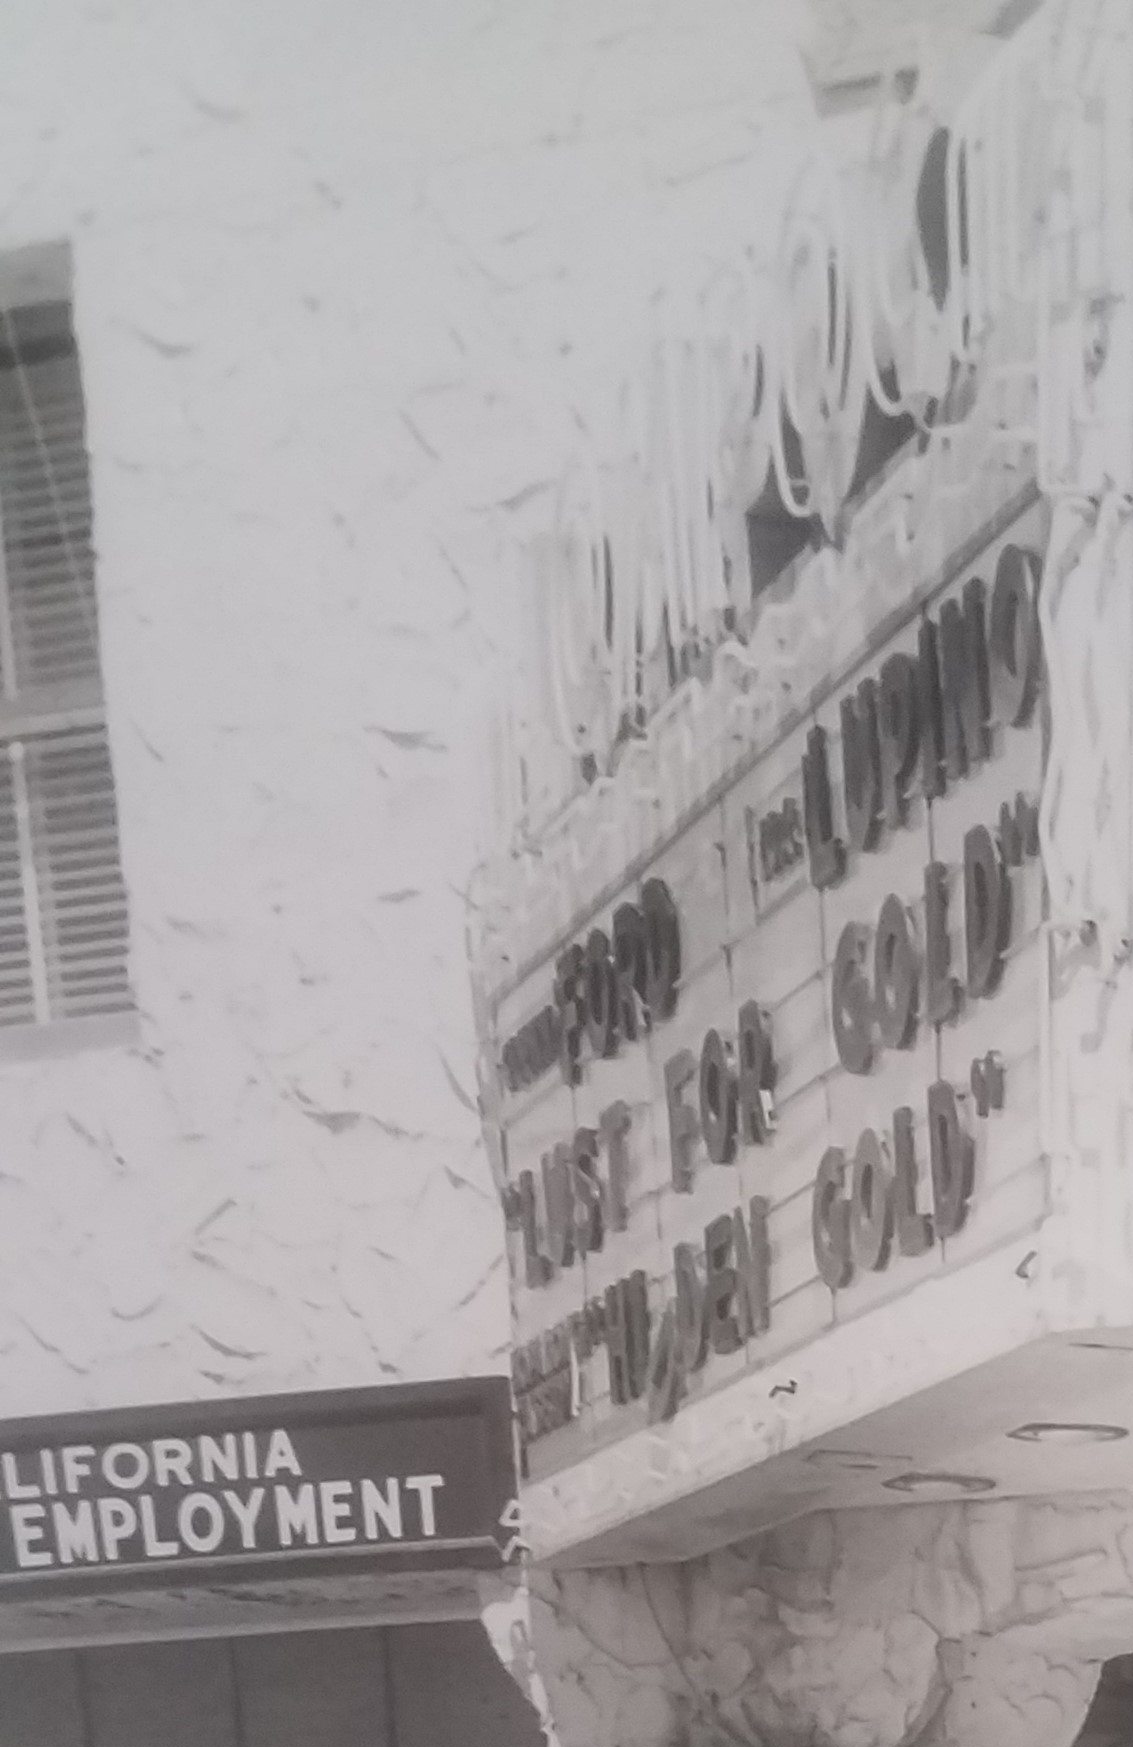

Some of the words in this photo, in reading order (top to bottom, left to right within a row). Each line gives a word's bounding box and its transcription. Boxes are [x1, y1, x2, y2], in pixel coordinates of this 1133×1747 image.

[662, 997, 777, 1195] FOR
[1, 1428, 302, 1499] LIFORNIA
[9, 1474, 446, 1567] EMPLOYMENT
